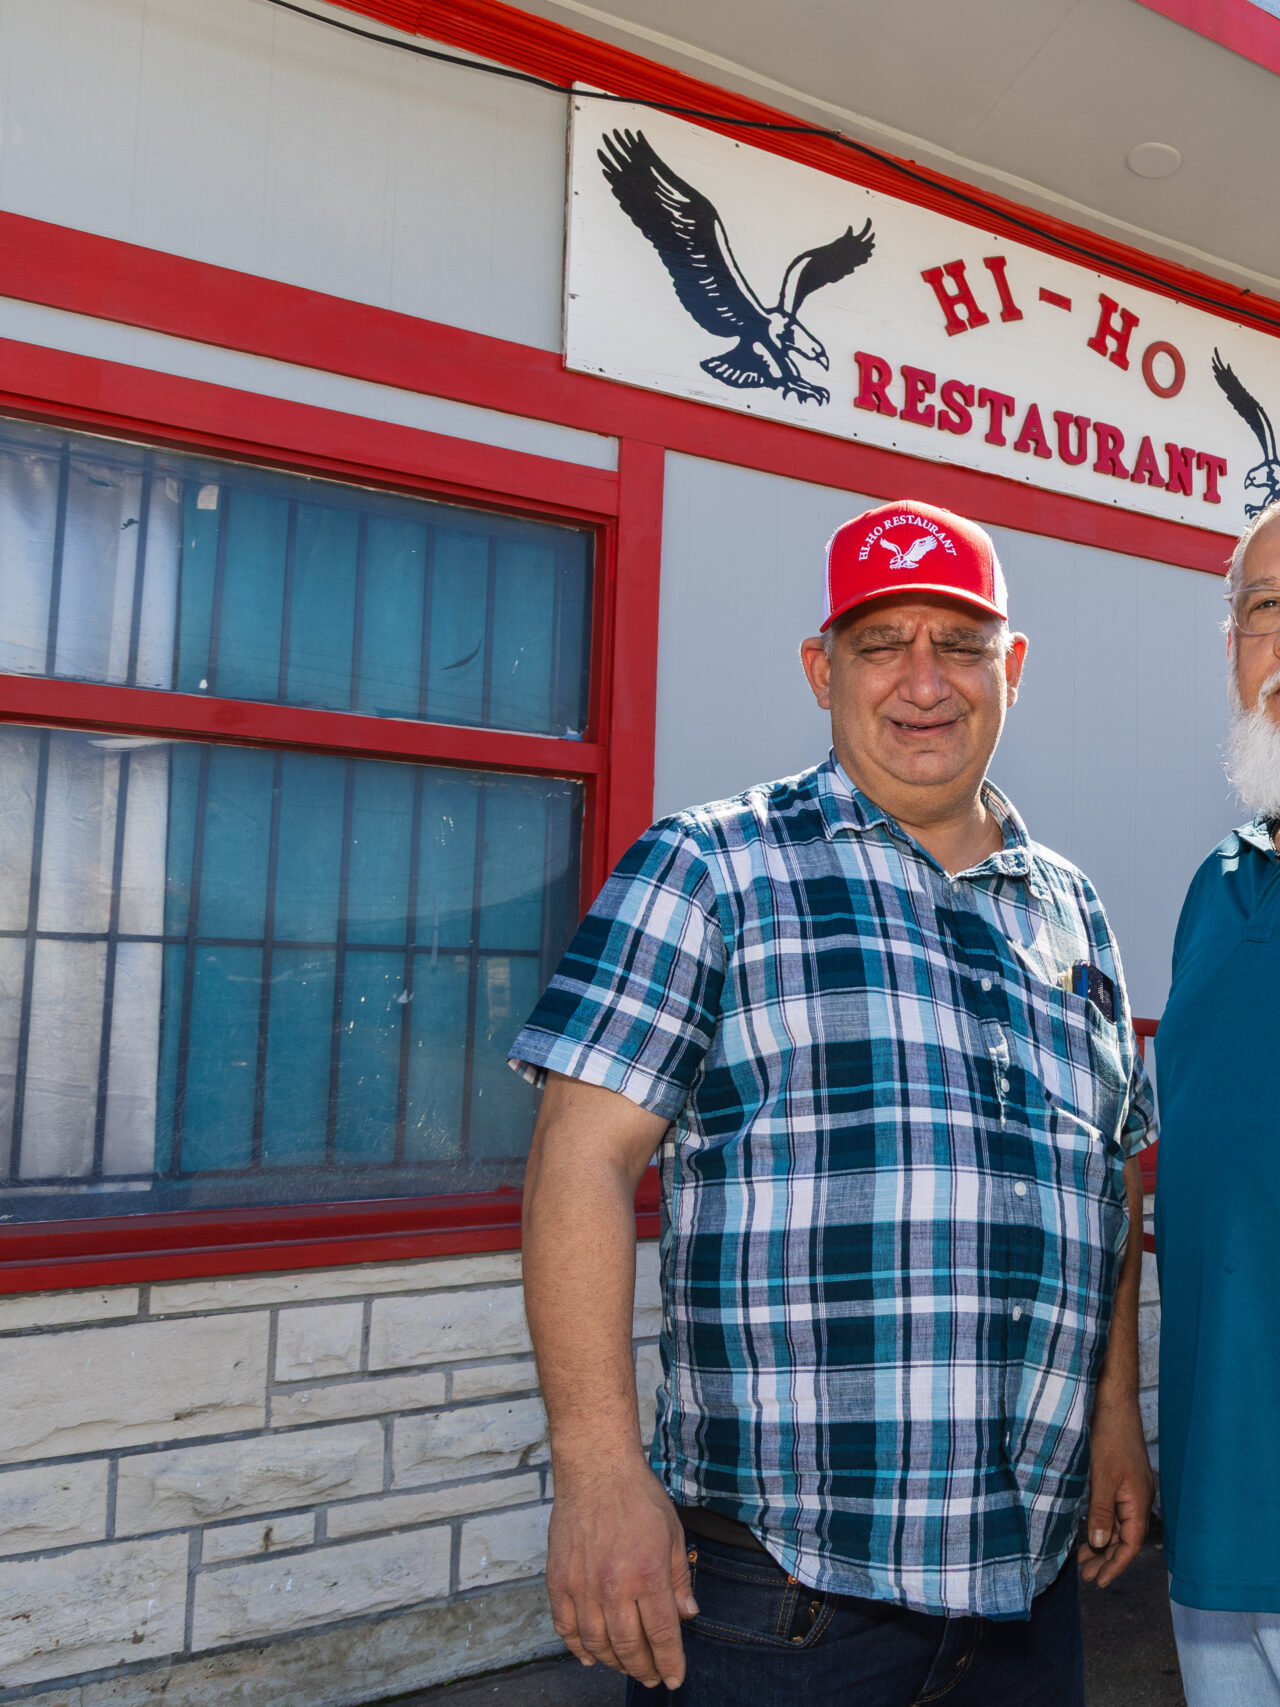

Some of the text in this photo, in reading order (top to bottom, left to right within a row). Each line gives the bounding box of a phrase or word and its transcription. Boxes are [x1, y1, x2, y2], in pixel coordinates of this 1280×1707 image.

[921, 256, 1186, 399] HI-HO
[853, 350, 1228, 504] RESTAURANT
[858, 514, 957, 561] HI-HO RESTAURANT
